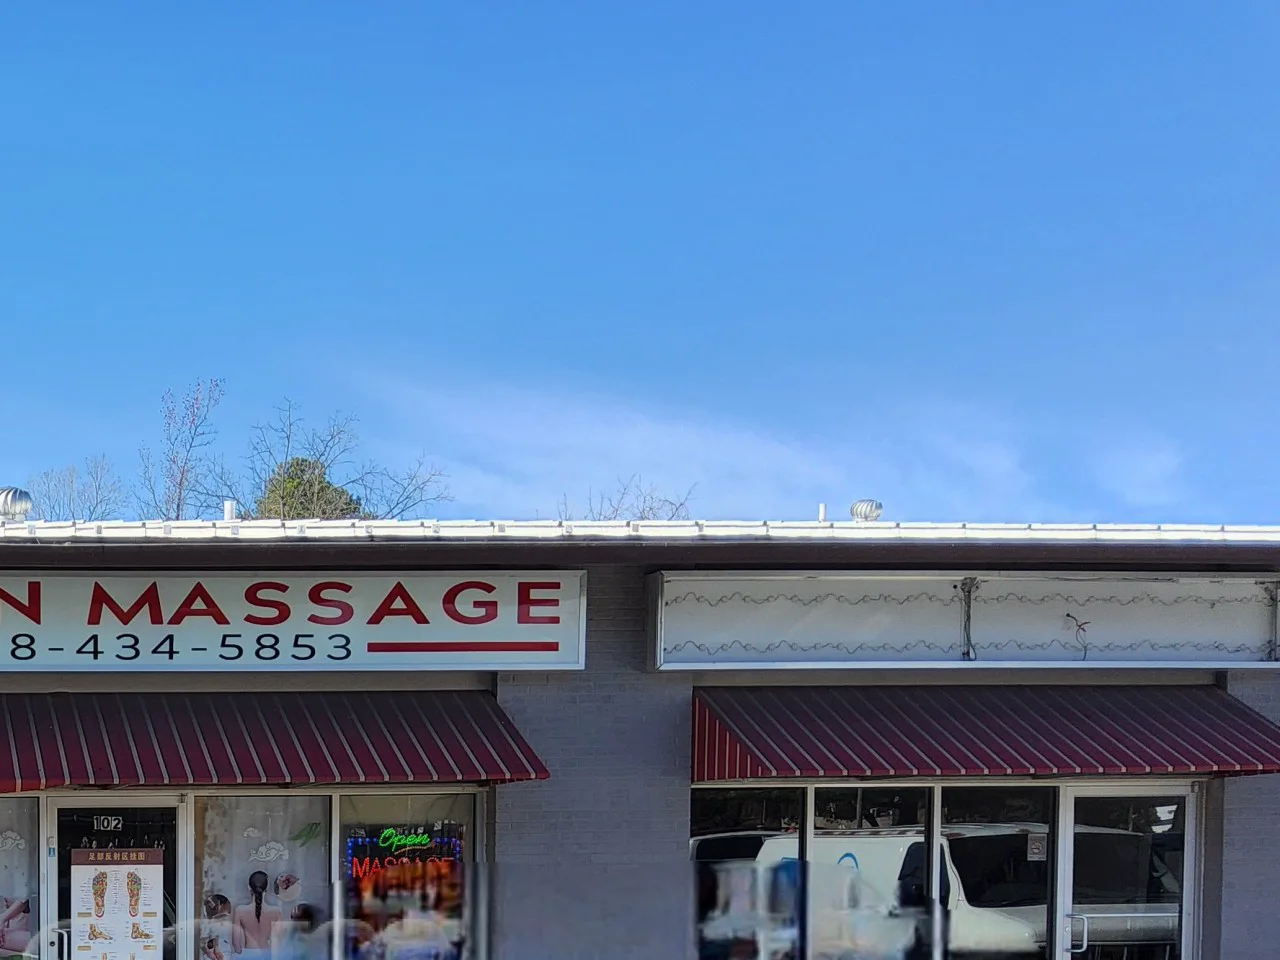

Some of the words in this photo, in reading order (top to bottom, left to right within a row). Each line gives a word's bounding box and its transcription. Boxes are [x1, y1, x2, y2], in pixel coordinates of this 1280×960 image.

[87, 580, 562, 627] MASSAGE
[94, 816, 122, 830] 102
[379, 827, 431, 852] Open
